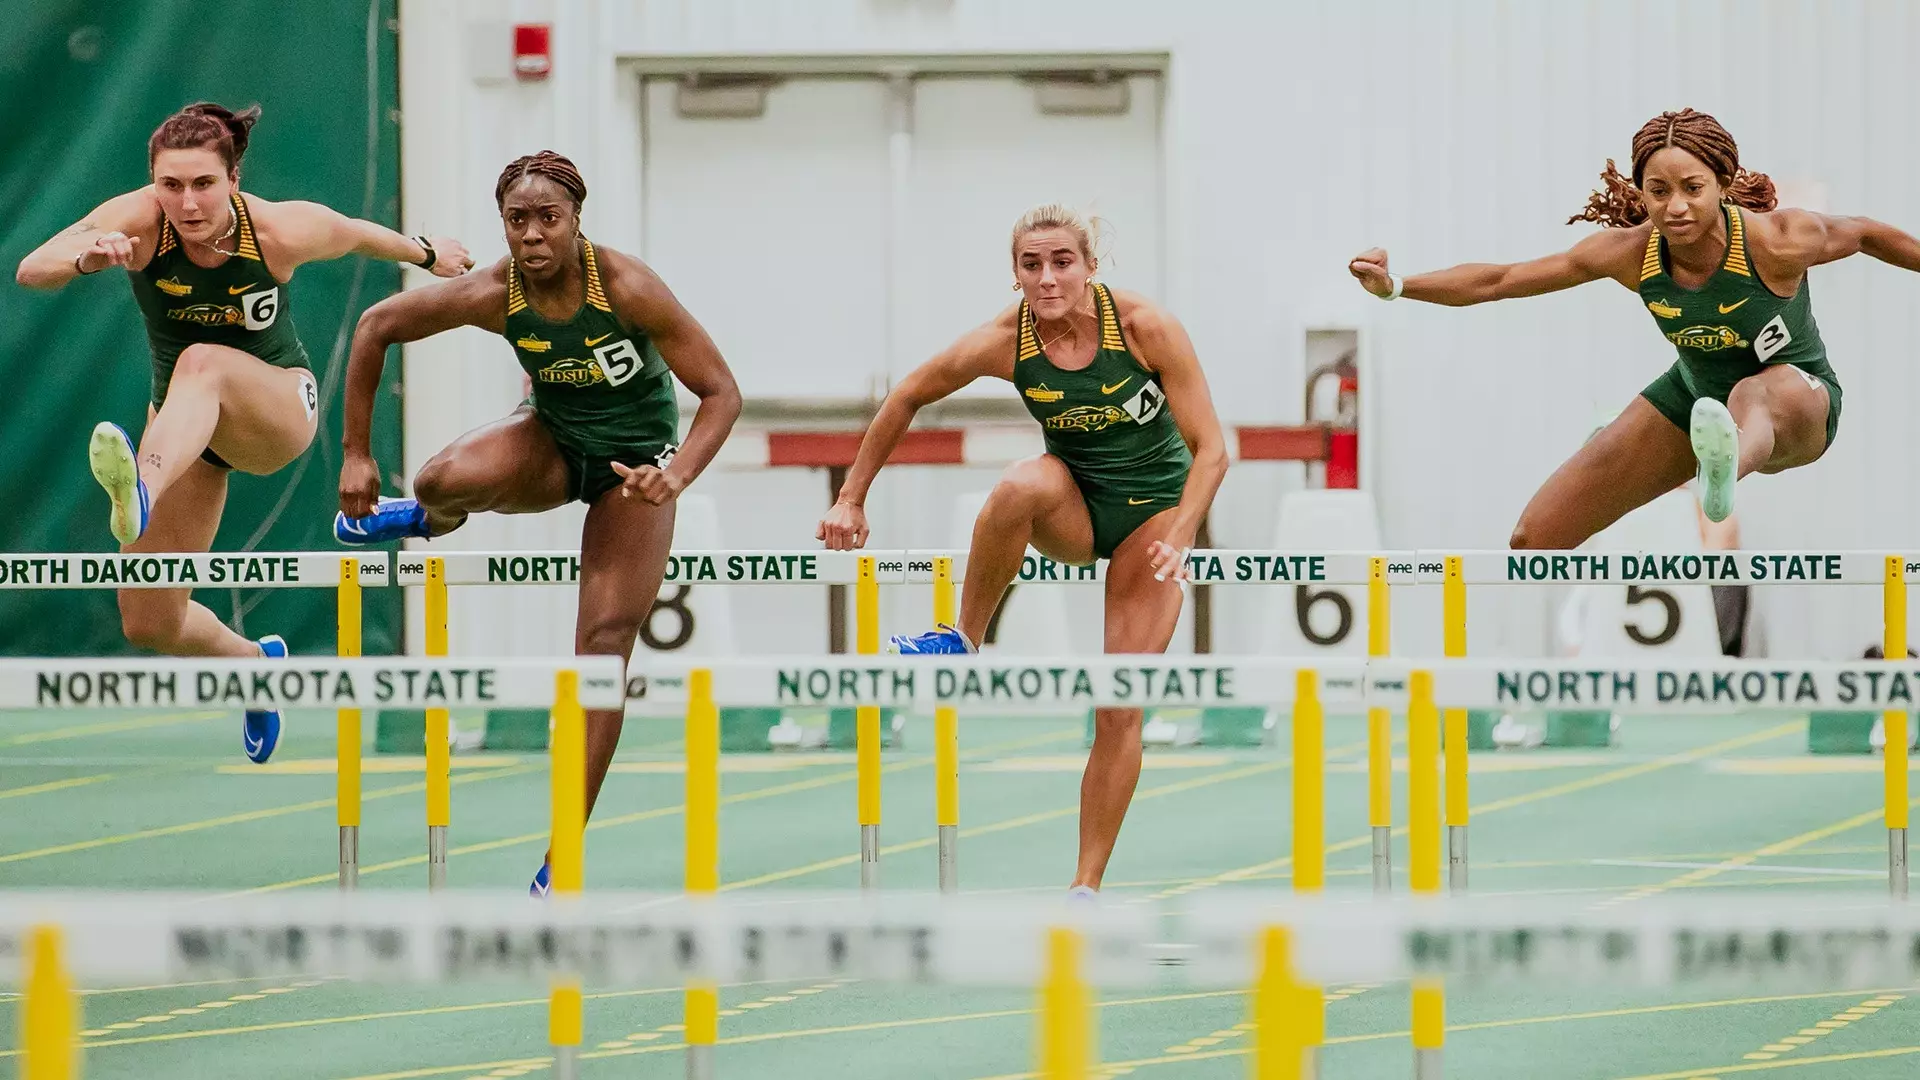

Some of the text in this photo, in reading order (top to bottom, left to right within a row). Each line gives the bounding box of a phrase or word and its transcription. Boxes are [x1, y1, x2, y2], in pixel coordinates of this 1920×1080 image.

[251, 294, 274, 322] 6
[1761, 324, 1785, 352] 3
[539, 368, 588, 383] NDSU
[602, 345, 635, 381] 5
[1137, 388, 1160, 420] 4
[1046, 413, 1104, 430] NDSU
[81, 558, 198, 584] DAKOTA
[208, 557, 300, 583] STATE
[662, 555, 718, 581] OTA
[726, 555, 817, 581] STATE
[1235, 555, 1326, 581] STATE
[1507, 554, 1842, 580] NORTH DAKOTA STATE
[1296, 586, 1352, 646] 6
[1624, 586, 1682, 646] 5
[36, 669, 496, 705] NORTH DAKOTA STATE
[777, 667, 1235, 702] NORTH DAKOTA STATE
[1496, 670, 1920, 704] NORTH DAKOTA STA
